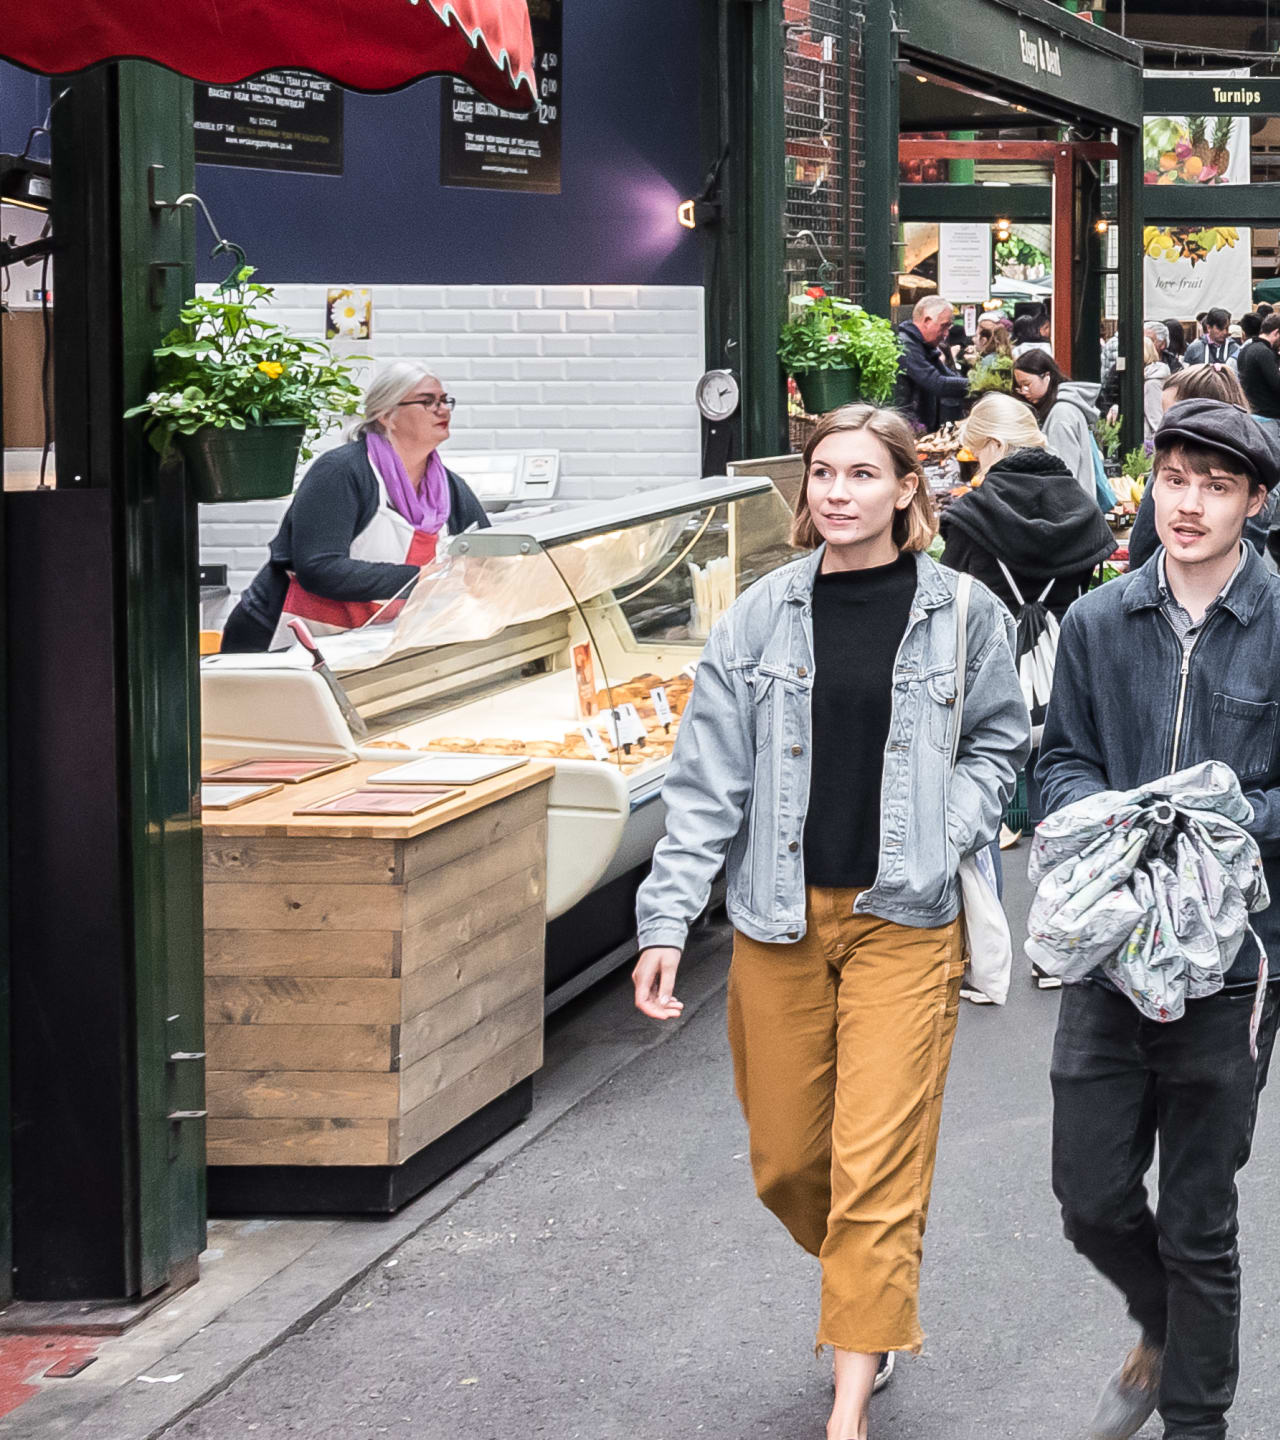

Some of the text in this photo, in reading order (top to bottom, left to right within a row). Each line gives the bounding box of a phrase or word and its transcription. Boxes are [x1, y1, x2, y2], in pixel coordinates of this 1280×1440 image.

[1212, 87, 1261, 105] Turnips
[1154, 276, 1204, 290] love fruit
